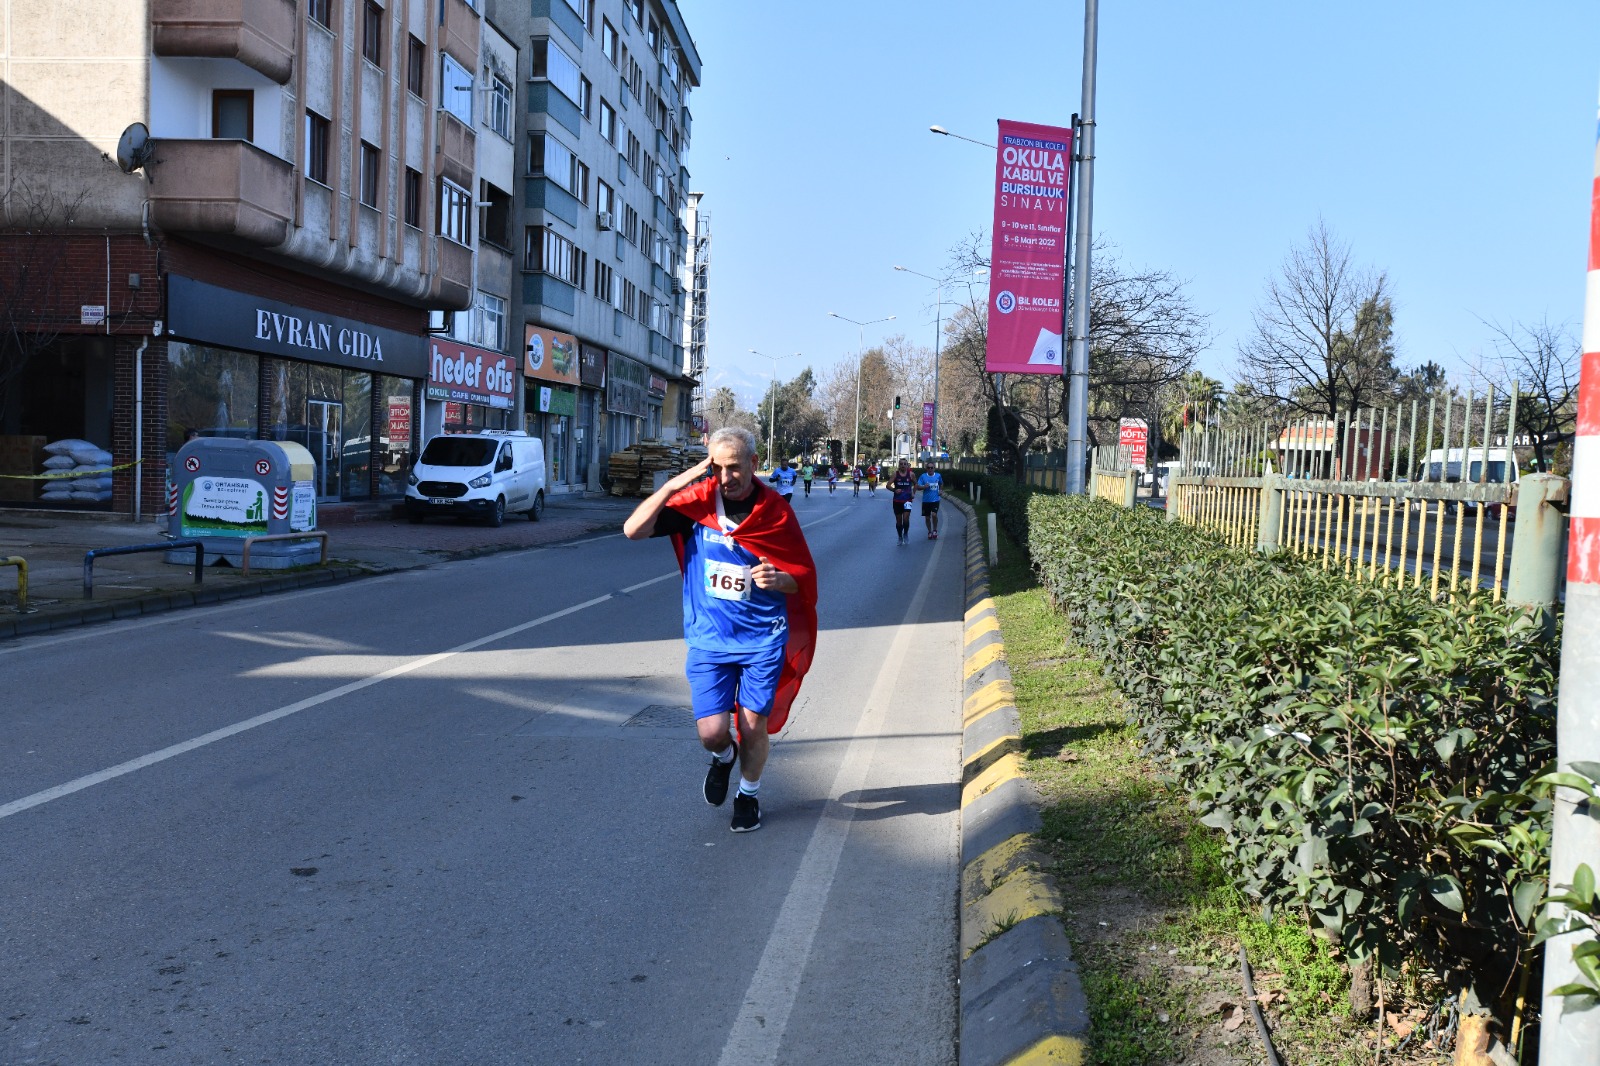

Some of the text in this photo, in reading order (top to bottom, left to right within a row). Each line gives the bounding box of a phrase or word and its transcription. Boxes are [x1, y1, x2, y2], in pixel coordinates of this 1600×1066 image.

[1004, 137, 1034, 147] TRABZON
[1003, 147, 1065, 171] OKULA
[1003, 166, 1064, 185] KABUL VE
[1002, 182, 1063, 198] BURSLULUK
[1001, 195, 1063, 212] SINAVI
[1020, 236, 1038, 245] Mart
[1038, 238, 1056, 247] 2022
[255, 308, 383, 361] EVRAN GIDA
[432, 344, 513, 394] hedef ofis
[429, 388, 449, 398] OKUL
[451, 391, 469, 400] CAFE
[1121, 429, 1146, 439] KÖFTE
[710, 574, 746, 592] 165
[771, 616, 787, 634] 22
